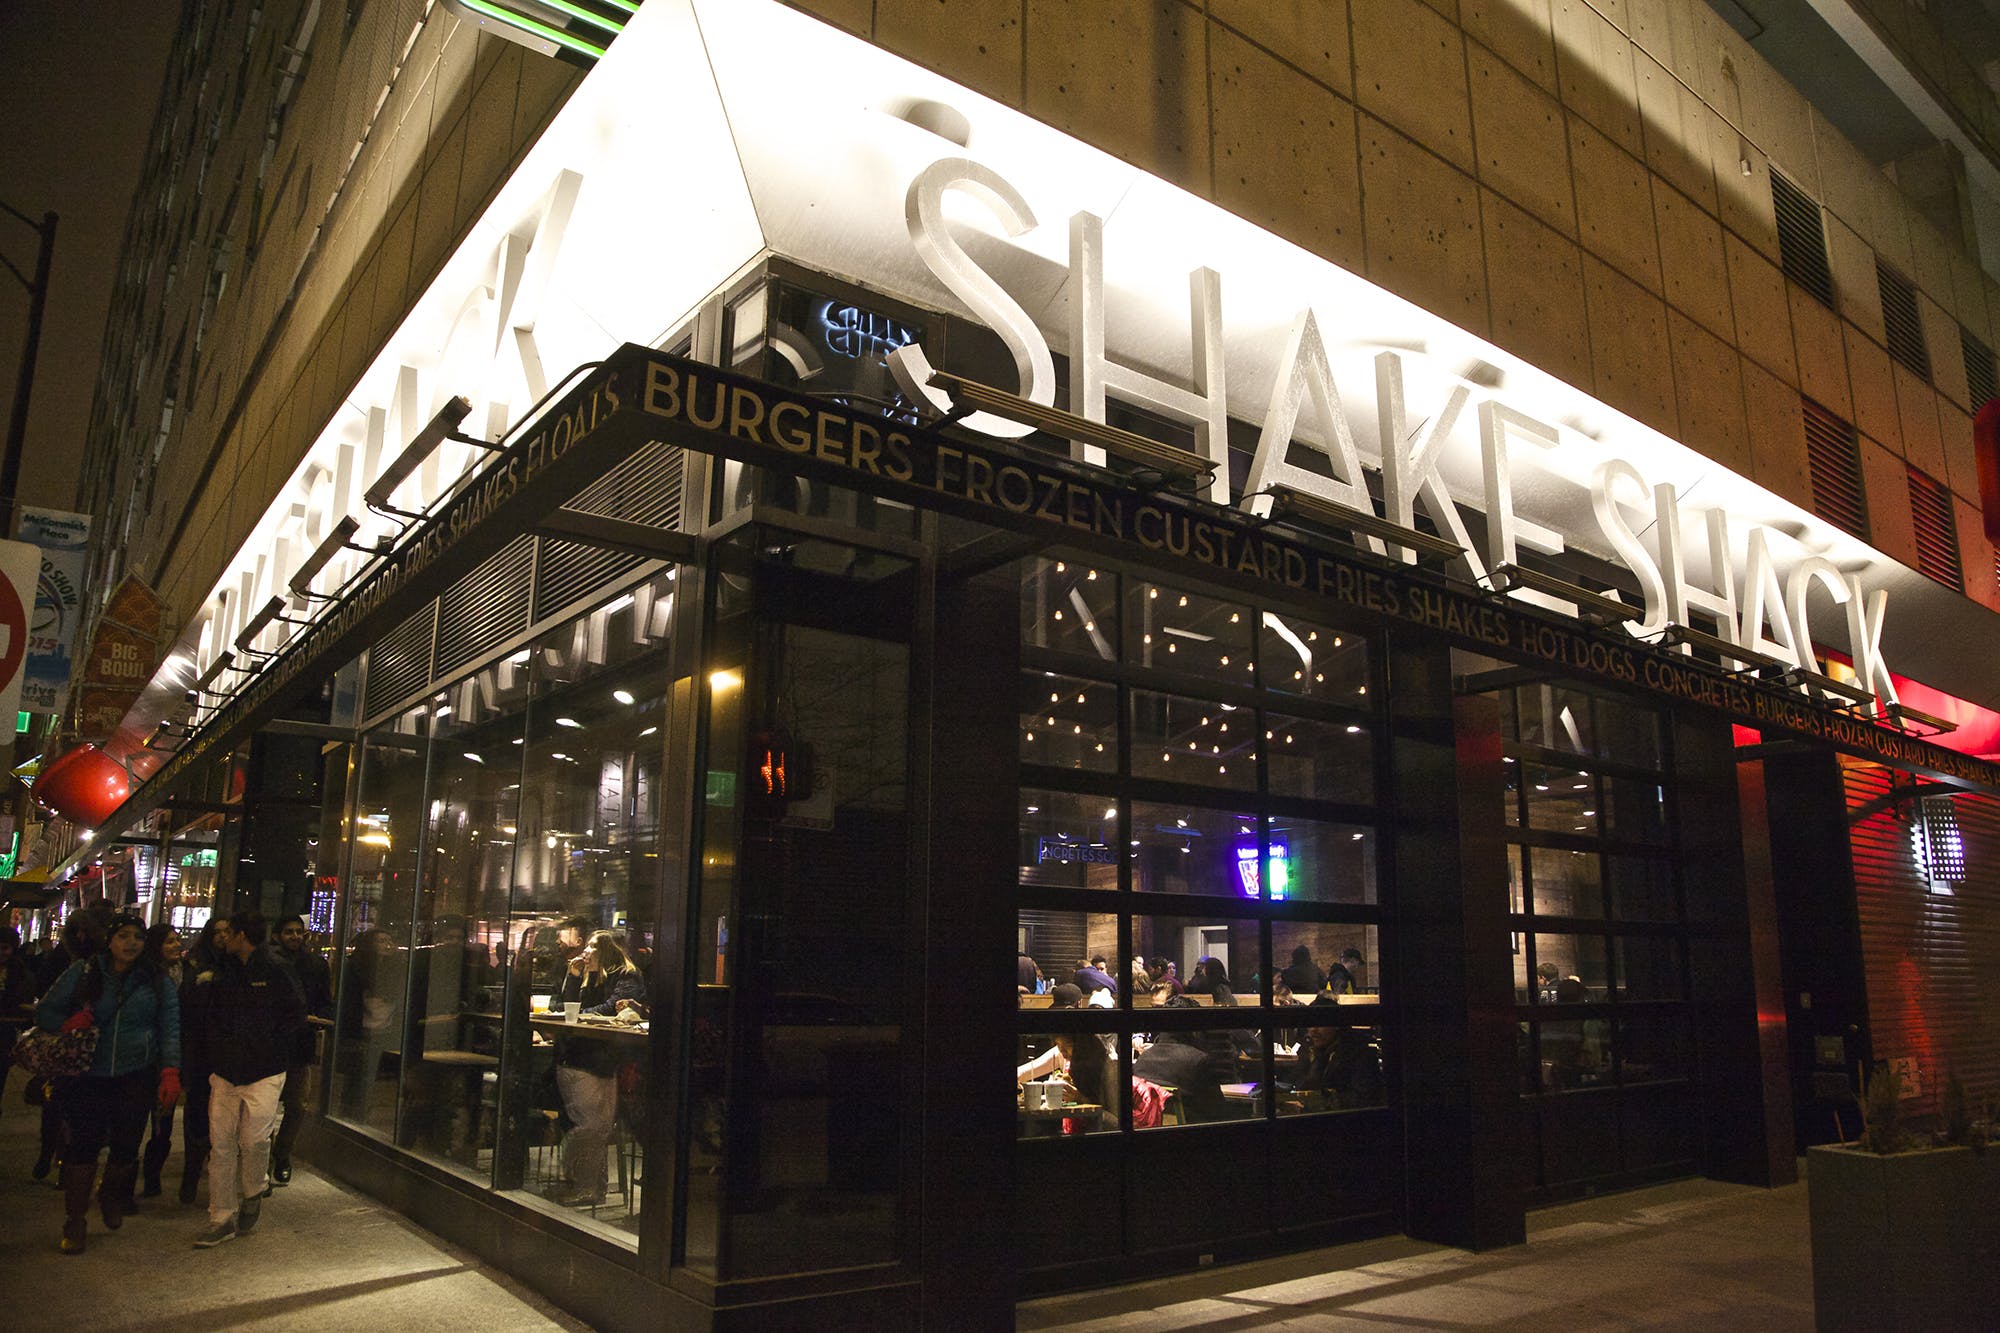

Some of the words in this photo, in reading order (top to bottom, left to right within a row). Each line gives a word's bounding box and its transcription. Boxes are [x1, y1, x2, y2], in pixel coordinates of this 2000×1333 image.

[886, 156, 1579, 617] SHAKE
[1592, 457, 1901, 730] SHACK
[403, 520, 445, 584] FRIES
[448, 456, 519, 544] SHAKES
[525, 371, 621, 484] FLOATS
[23, 513, 88, 533] McCormick
[39, 526, 69, 540] Place
[643, 360, 913, 482] BURGERS
[935, 444, 1124, 540] FROZEN
[1134, 505, 1307, 588] CUSTARD
[1317, 563, 1400, 616] FRIES
[1408, 586, 1510, 646] SHAKES
[1520, 618, 1570, 664] HOT
[1574, 638, 1636, 682] DOGS
[1644, 654, 1751, 713] CONCRETES
[1755, 691, 1821, 736] BURGERS
[1824, 717, 1874, 750] FROZEN
[1875, 731, 1926, 766] CUSTARD
[1928, 748, 1956, 777] FRIES
[49, 569, 77, 605] SHOW
[112, 641, 138, 661] BIG
[101, 659, 146, 679] BOWL
